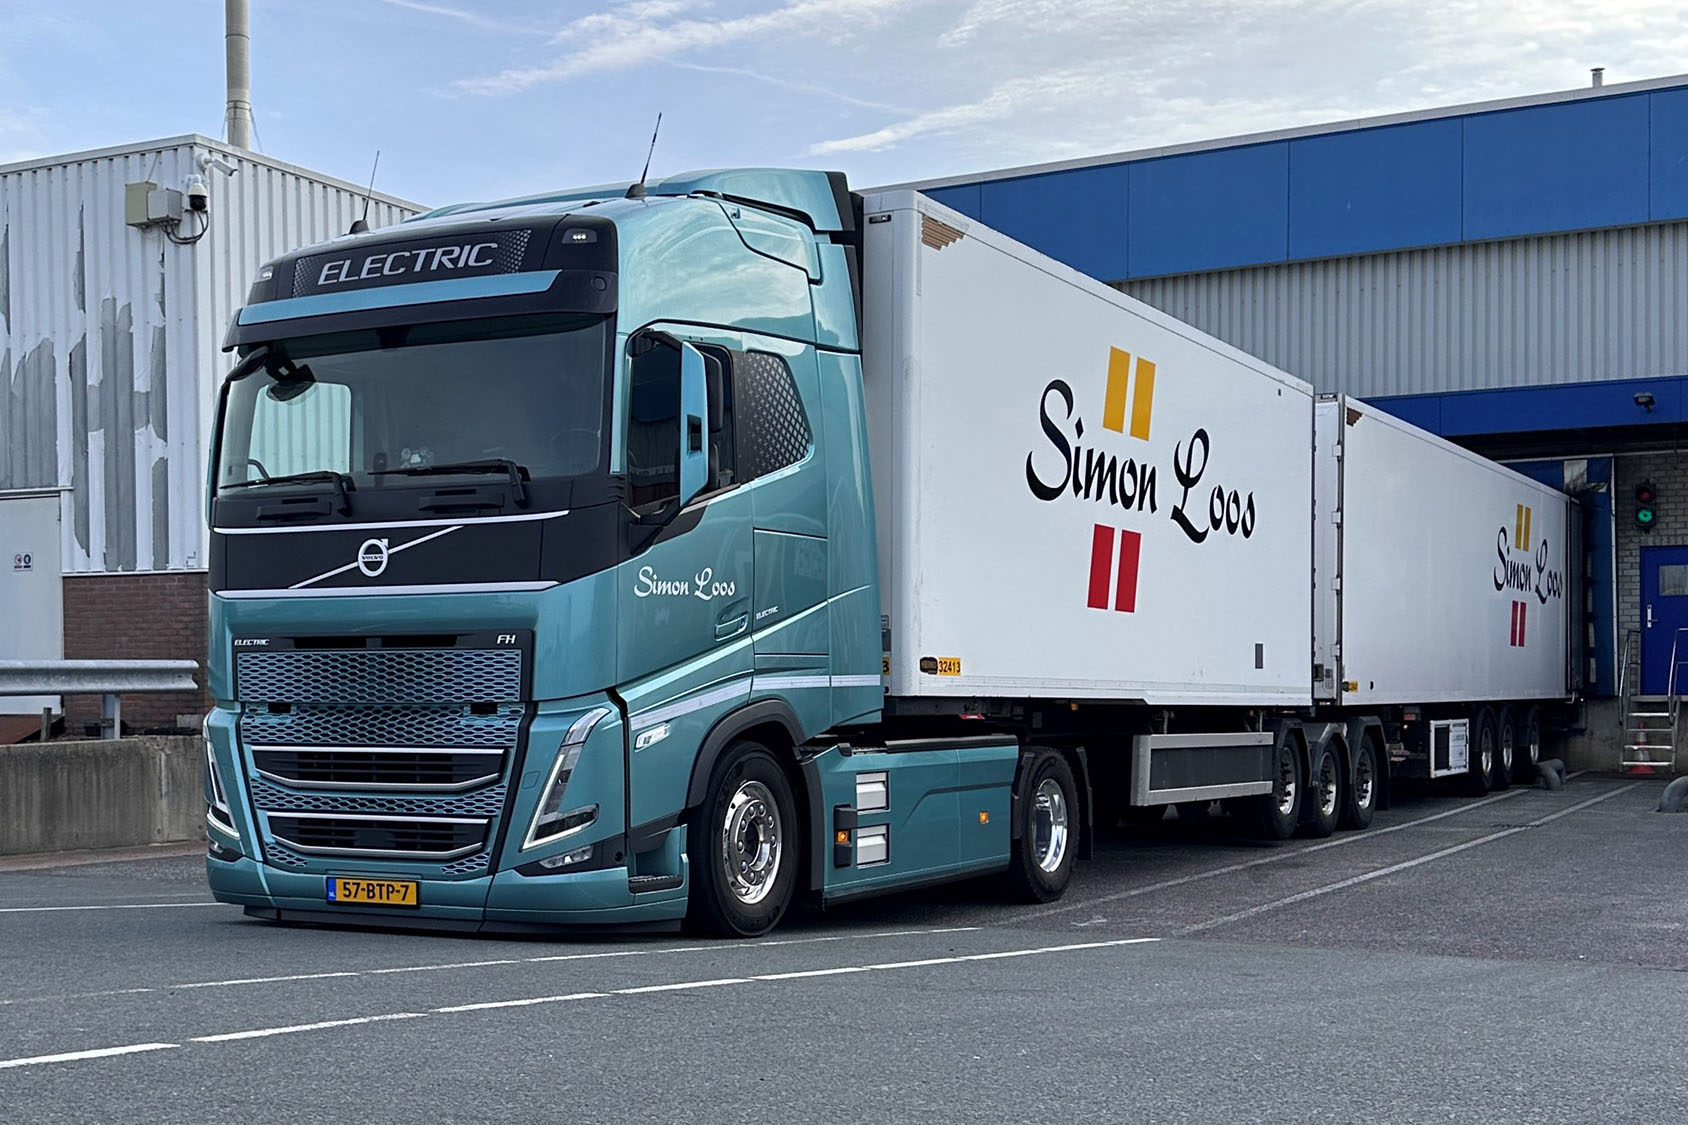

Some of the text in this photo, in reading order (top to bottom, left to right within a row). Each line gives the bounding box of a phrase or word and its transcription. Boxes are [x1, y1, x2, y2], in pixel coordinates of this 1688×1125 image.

[318, 243, 498, 286] ELECTRIC
[1026, 379, 1256, 544] Simon Loos
[1494, 526, 1562, 605] Simon Loos
[634, 566, 736, 600] Simon Loos
[756, 605, 779, 620] ELECTRIC
[496, 634, 516, 645] FH
[939, 660, 961, 673] 32413
[342, 881, 410, 901] 57-BTP-7
